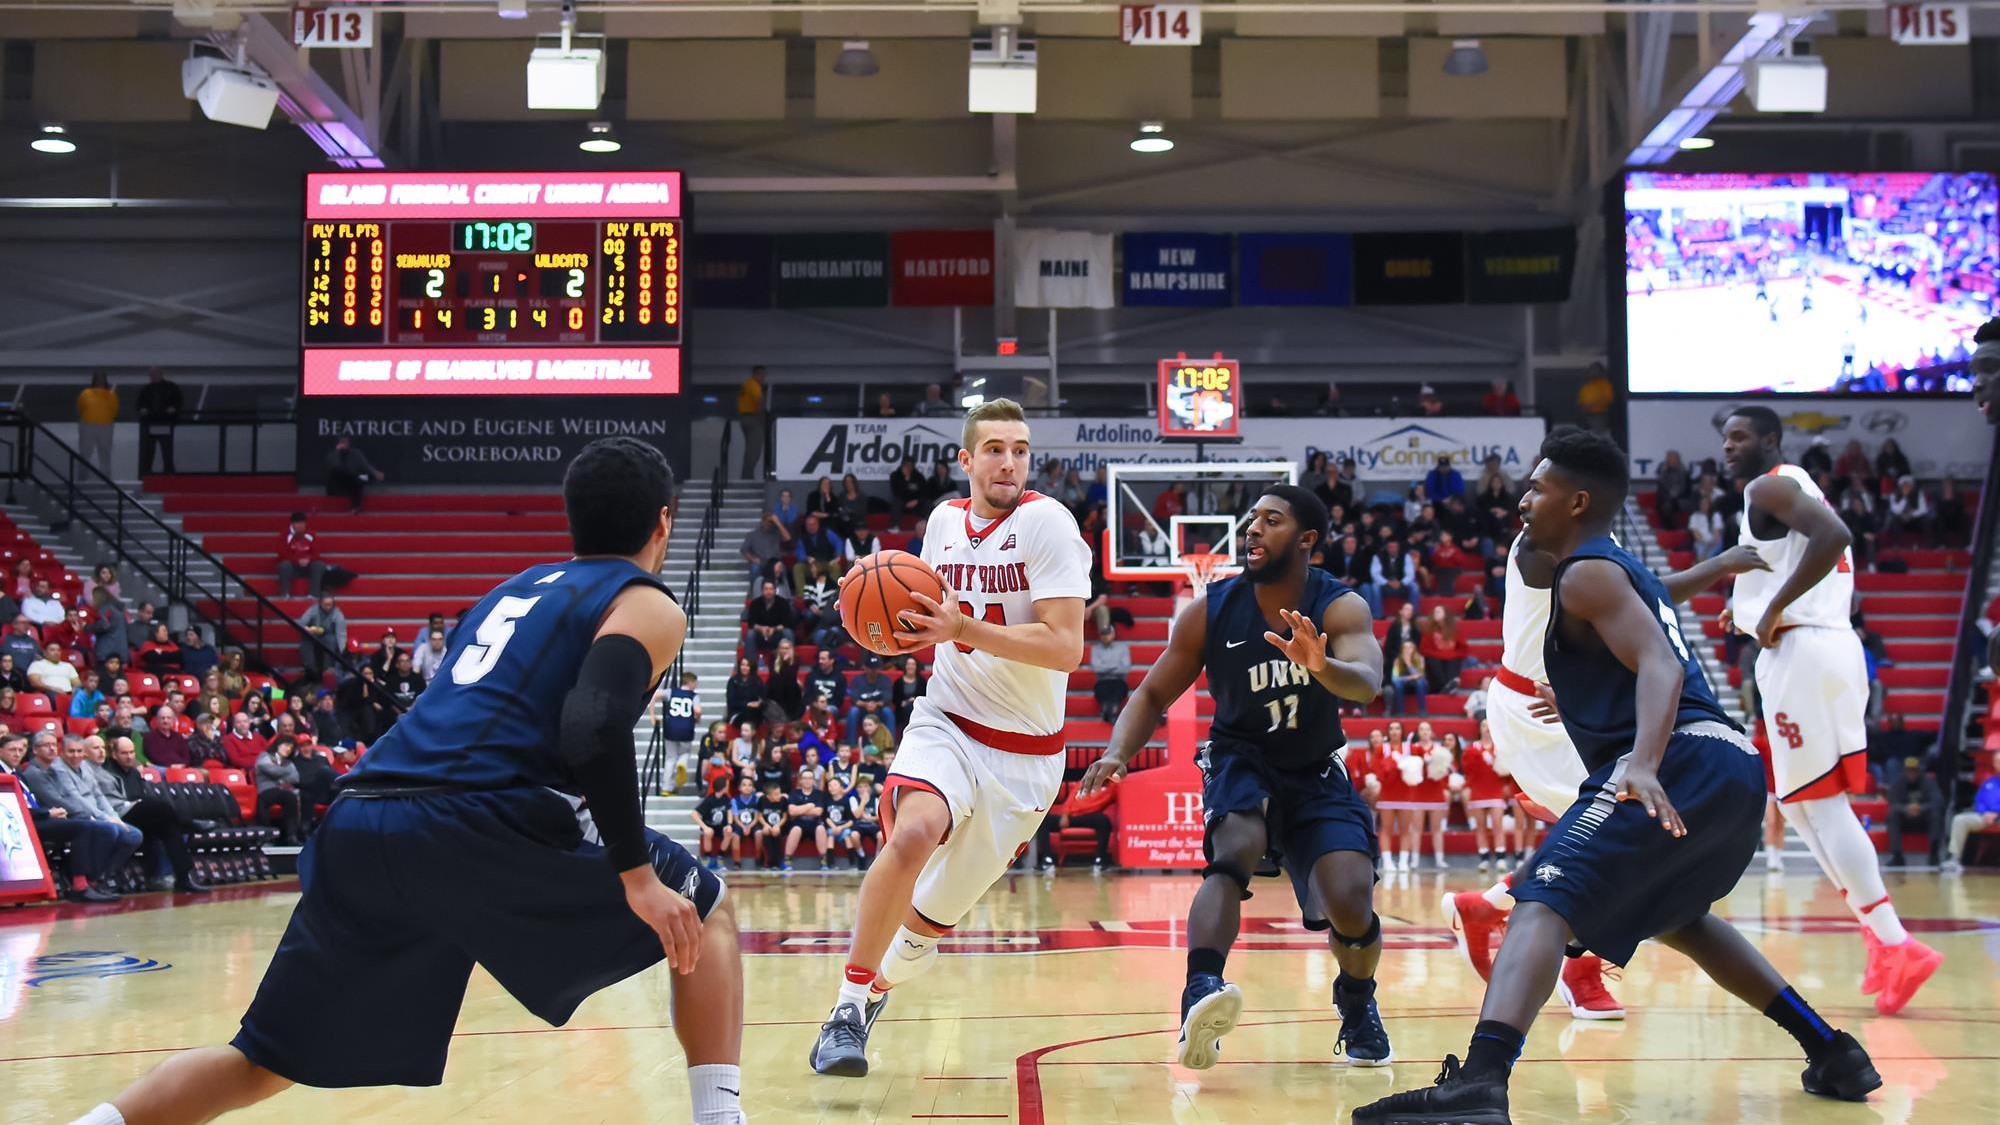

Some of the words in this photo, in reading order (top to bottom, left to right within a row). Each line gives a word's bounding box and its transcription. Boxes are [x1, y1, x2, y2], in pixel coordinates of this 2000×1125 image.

[315, 12, 361, 42] 113
[1143, 10, 1190, 39] 114
[1912, 8, 1957, 38] 115
[312, 224, 334, 238] PLY
[338, 224, 354, 238] FL
[356, 224, 379, 238] PTS
[465, 222, 532, 251] 17:02
[607, 223, 629, 237] PLY
[633, 223, 648, 237] FL
[650, 223, 673, 237] PTS
[321, 240, 331, 257] 3
[371, 239, 382, 256] 0
[603, 239, 625, 255] 00
[640, 238, 651, 255] 0
[666, 238, 677, 255] 2
[345, 256, 356, 273] 0
[371, 256, 382, 273] 0
[640, 255, 651, 271] 0
[666, 255, 677, 271] 0
[1159, 248, 1196, 267] NEW
[781, 260, 883, 279] BINGHAMTON
[904, 258, 990, 278] HARTFORD
[1040, 260, 1089, 278] MAINE
[314, 274, 330, 291] 12
[345, 274, 356, 291] 0
[371, 274, 382, 291] 0
[426, 269, 444, 298] 2
[493, 274, 500, 293] 1
[566, 269, 584, 298] 2
[639, 273, 651, 289] 0
[665, 273, 677, 289] 0
[1130, 271, 1225, 290] HAMPSHIRE
[308, 291, 329, 308] 24
[344, 291, 356, 308] 0
[371, 291, 381, 307] 2
[609, 290, 624, 306] 12
[639, 289, 651, 306] 0
[665, 289, 677, 306] 0
[309, 308, 329, 326] 34
[344, 308, 355, 326] 0
[370, 308, 382, 326] 0
[414, 309, 422, 329] 1
[437, 309, 452, 329] 4
[483, 308, 496, 330] 3
[510, 309, 517, 328] 1
[532, 309, 547, 328] 4
[568, 307, 583, 329] 0
[603, 307, 624, 324] 21
[639, 307, 650, 324] 0
[665, 307, 677, 324] 0
[1177, 367, 1230, 391] 17:02
[318, 418, 413, 436] BEATRICE
[419, 420, 466, 435] AND
[473, 418, 555, 435] EUGENE
[562, 417, 666, 435] WEIDMAN
[855, 423, 887, 434] TEAM
[1077, 424, 1152, 444] Ardolino
[423, 444, 562, 462] SCOREBOARD
[801, 424, 960, 476] Ardolino
[452, 596, 542, 685] 5
[669, 696, 693, 718] 50
[1775, 711, 1804, 750] SB
